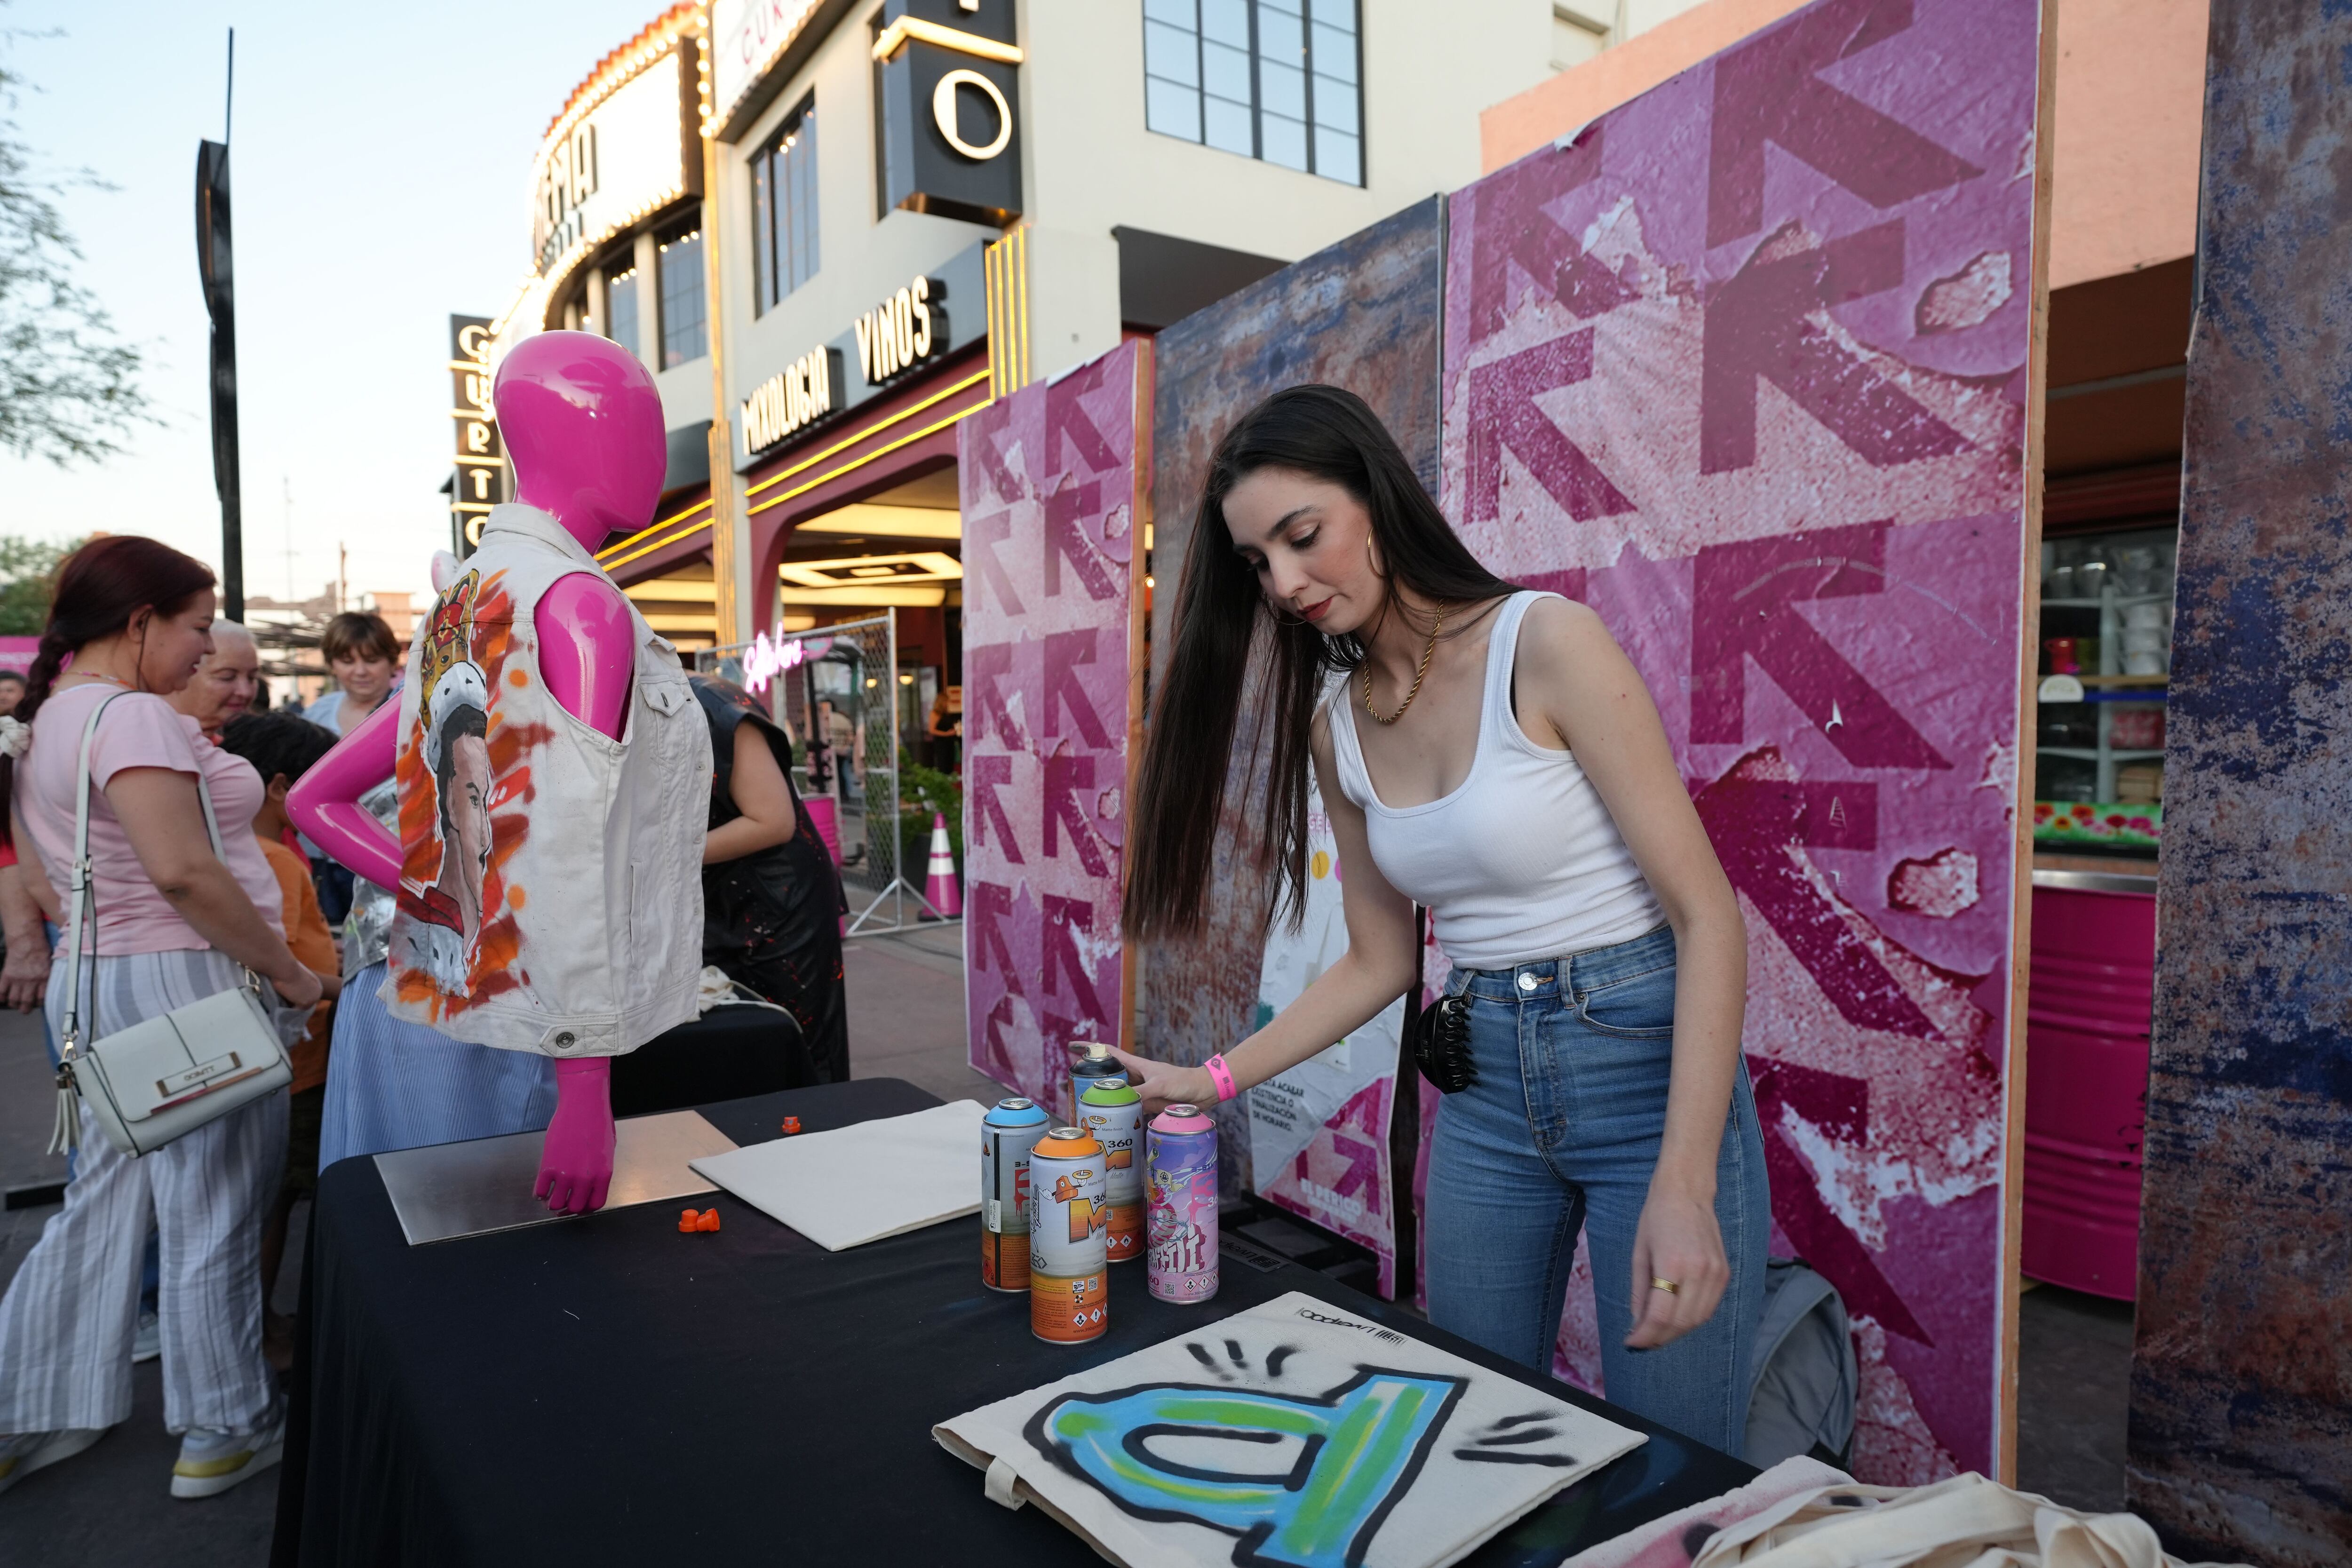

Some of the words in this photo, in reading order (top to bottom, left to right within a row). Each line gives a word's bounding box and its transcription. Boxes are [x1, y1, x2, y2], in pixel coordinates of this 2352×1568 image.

[854, 274, 931, 383] VINOS
[1288, 1098, 1294, 1107] O
[1108, 1138, 1133, 1148] 360
[1295, 1307, 1377, 1333] Liverpool
